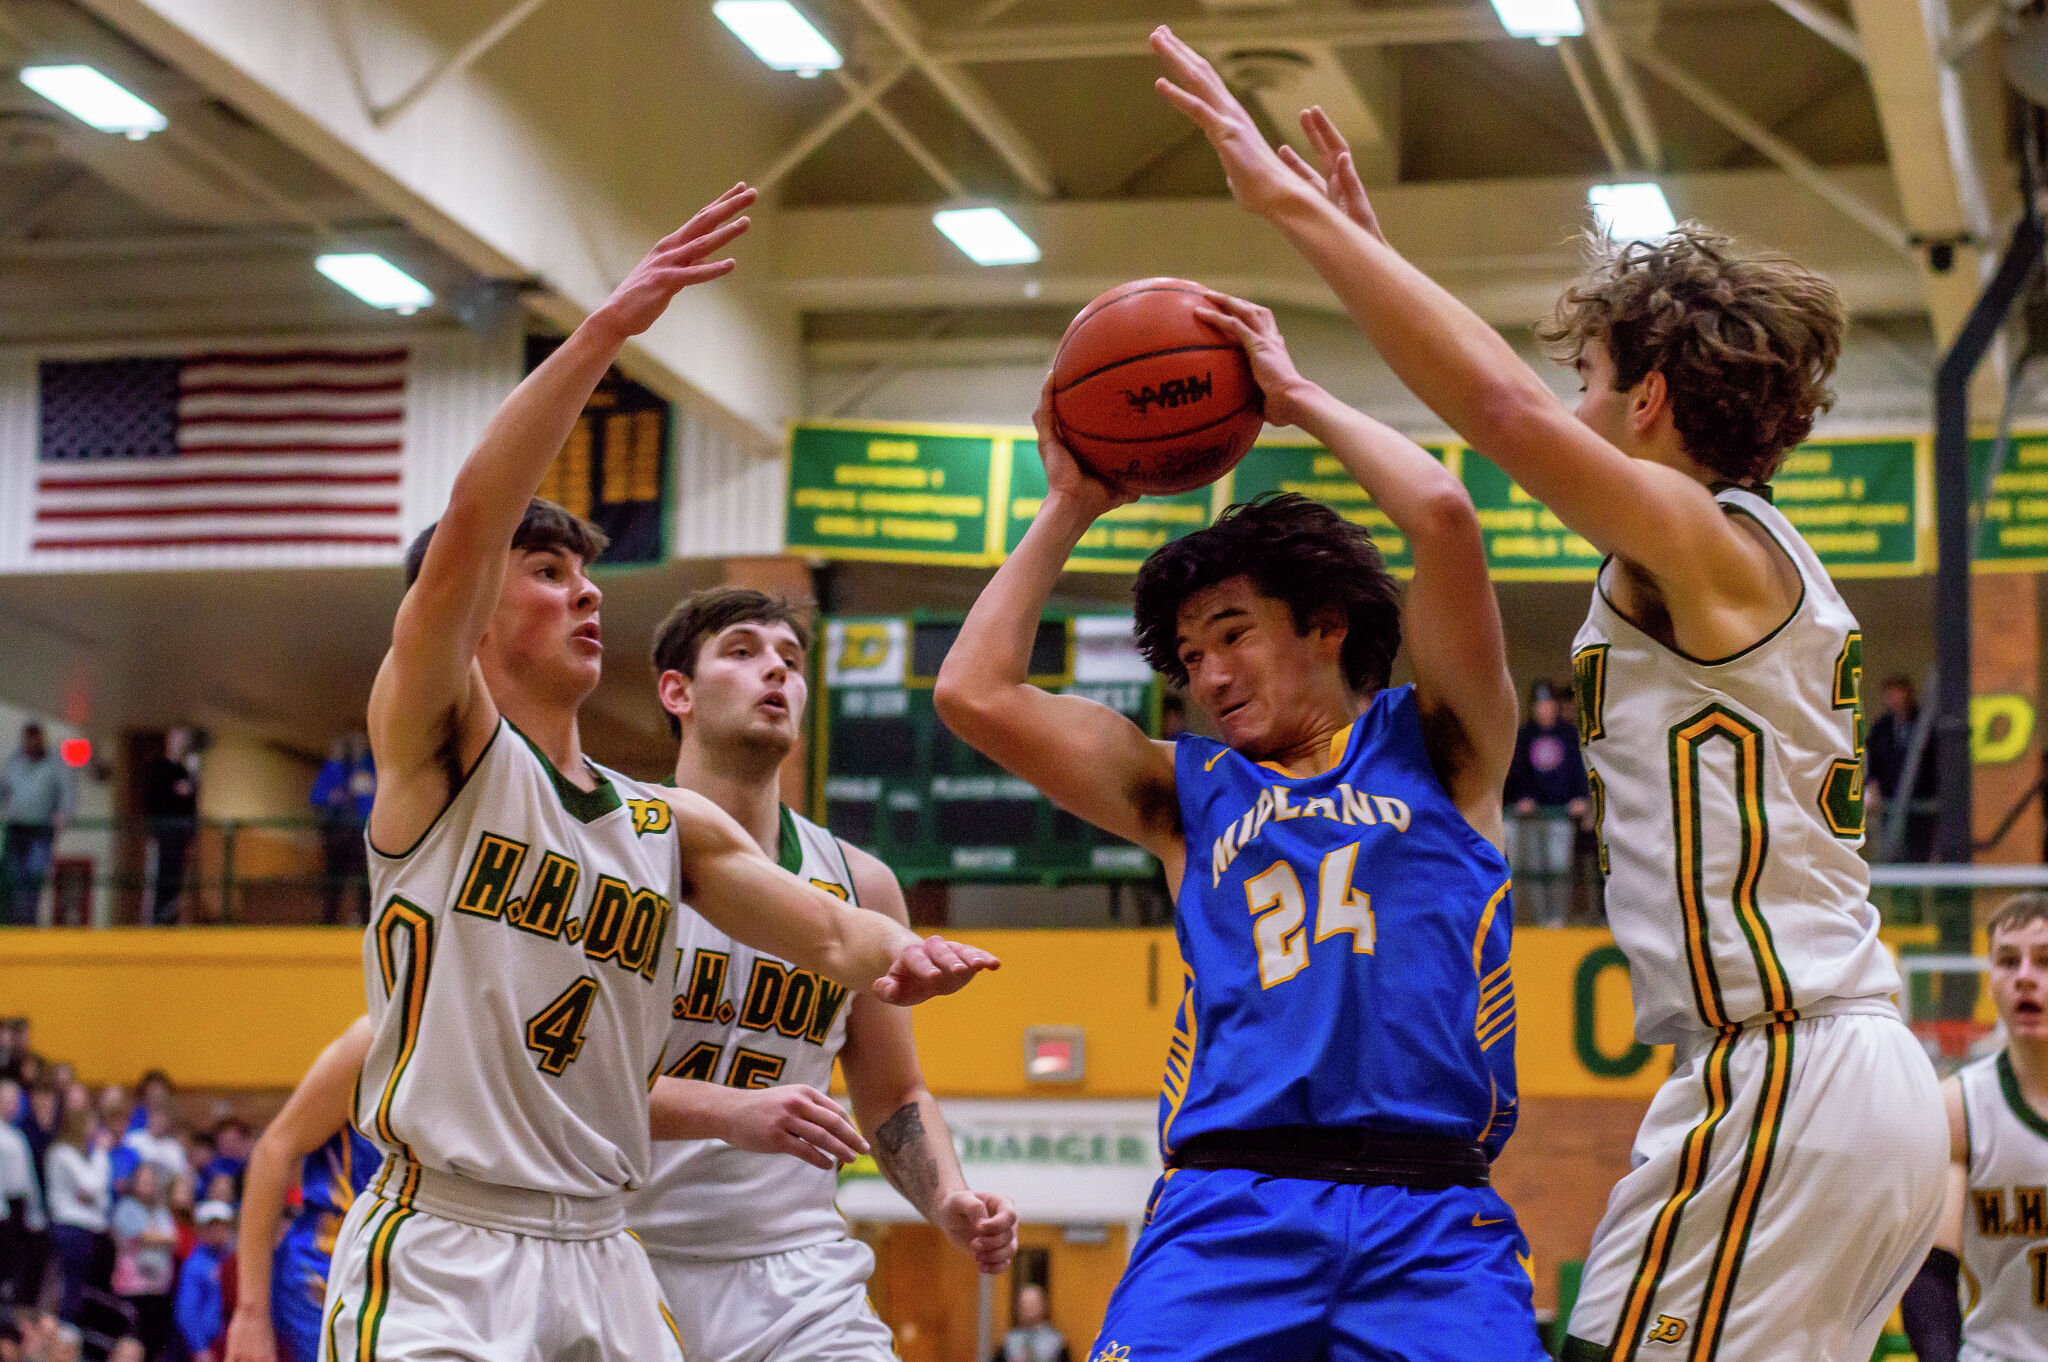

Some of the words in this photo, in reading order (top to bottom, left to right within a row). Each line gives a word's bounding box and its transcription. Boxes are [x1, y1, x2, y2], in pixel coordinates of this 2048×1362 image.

[1212, 782, 1412, 890] MIDLAND
[1243, 841, 1377, 991] 24
[526, 974, 598, 1077] 4
[736, 956, 849, 1047] DOW
[960, 1135, 1150, 1166] HARGER
